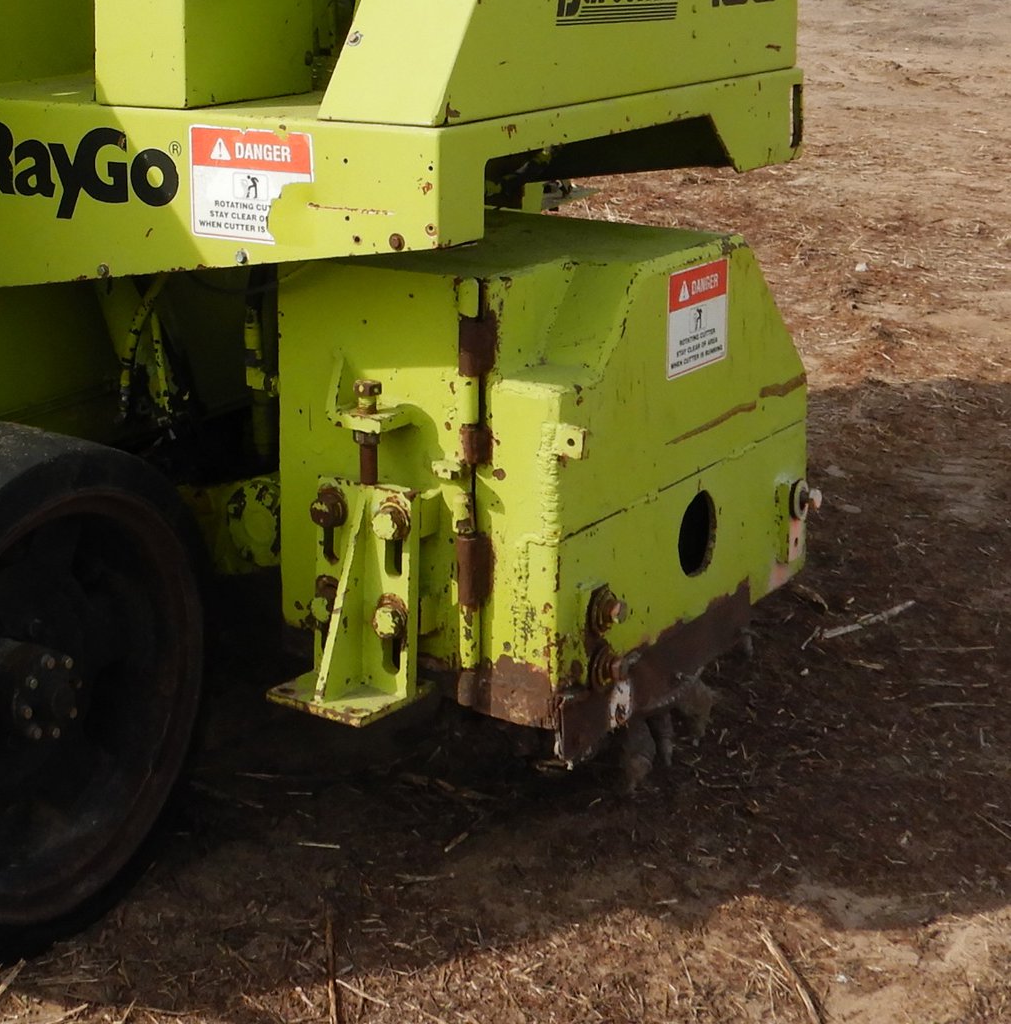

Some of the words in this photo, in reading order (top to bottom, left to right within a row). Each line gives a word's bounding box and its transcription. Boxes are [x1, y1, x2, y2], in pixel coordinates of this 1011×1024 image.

[234, 142, 292, 163] DANGER
[214, 200, 254, 210] ROTATING
[209, 210, 229, 218] STAY
[230, 212, 257, 221] CLEAR
[199, 220, 222, 228] WHEN
[223, 222, 256, 232] CUTTER
[257, 225, 266, 233] IS
[691, 273, 719, 295] DANGER
[679, 333, 699, 346] ROTATING
[699, 328, 716, 339] CUTTER
[687, 343, 700, 354] CLEAR
[670, 360, 683, 370] WHEN
[683, 353, 700, 364] CUTTER
